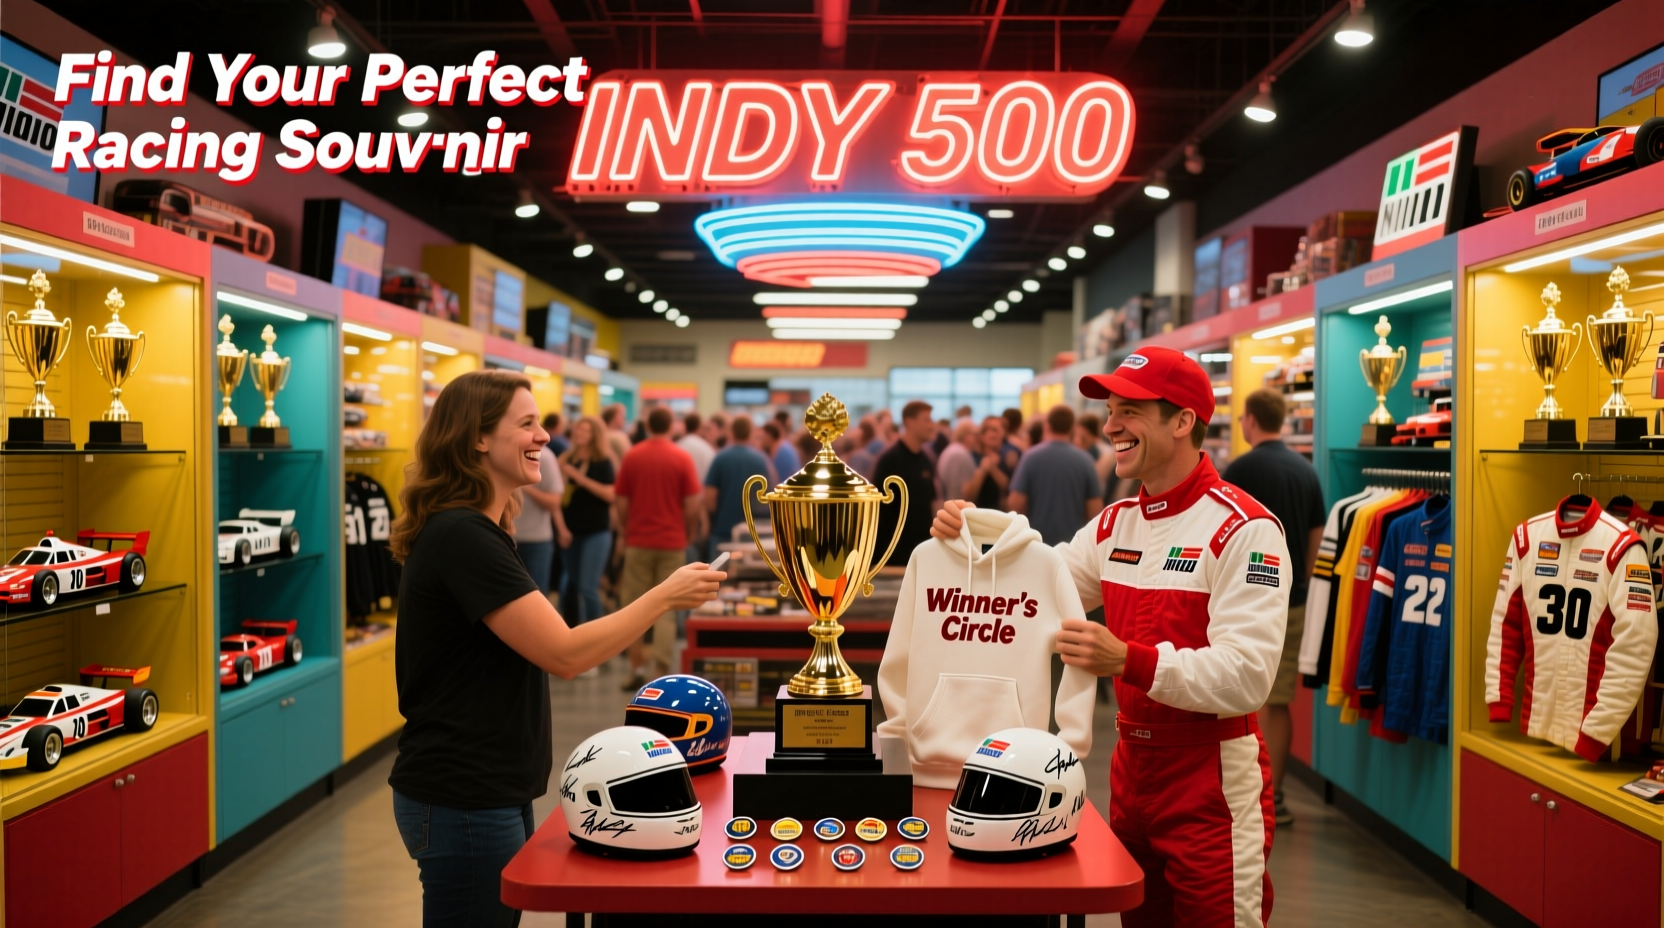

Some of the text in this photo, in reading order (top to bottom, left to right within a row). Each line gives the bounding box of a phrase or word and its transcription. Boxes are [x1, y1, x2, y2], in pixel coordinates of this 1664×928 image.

[566, 78, 1134, 188] INDY 500
[926, 587, 1039, 618] Winner's
[1401, 574, 1446, 627] 22
[1536, 583, 1592, 640] 30
[941, 615, 1016, 645] Circle
